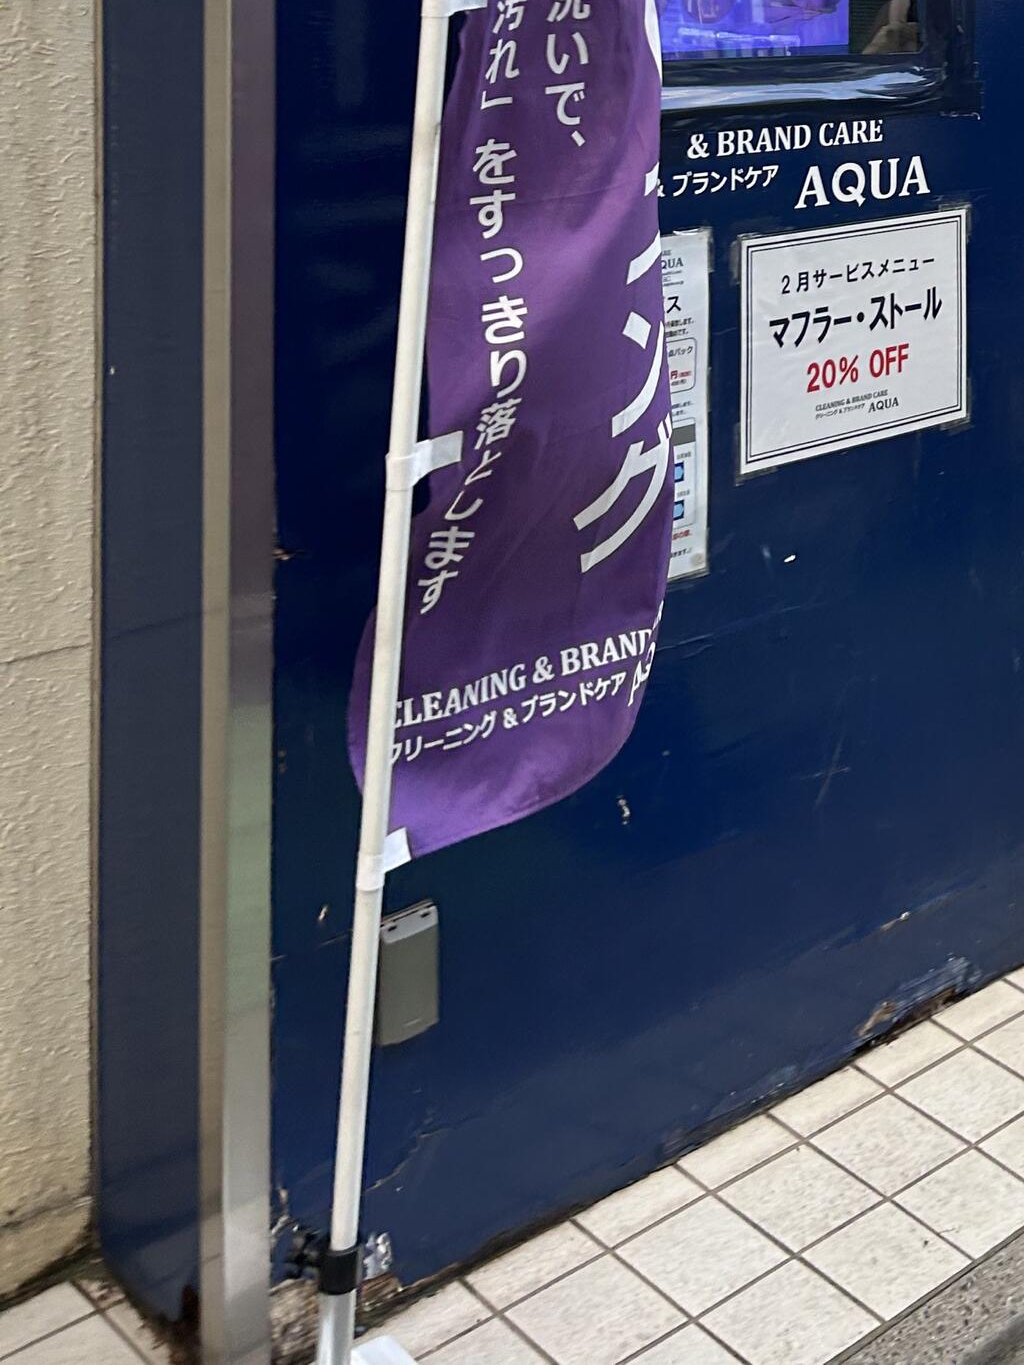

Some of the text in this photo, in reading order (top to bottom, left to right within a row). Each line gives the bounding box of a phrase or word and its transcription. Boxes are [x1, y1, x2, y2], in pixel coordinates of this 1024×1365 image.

[686, 118, 884, 160] & BRAND CARE
[672, 164, 780, 198] ブランドケア
[794, 155, 931, 209] AQUA
[781, 258, 935, 295] 2月サービスメニュー
[769, 286, 943, 349] マフラー・ストール
[806, 342, 910, 393] 20% OFF
[815, 397, 845, 412] CLEANING
[851, 392, 873, 404] BRAND
[873, 389, 889, 399] CARE
[868, 396, 899, 413] AQUA
[532, 655, 556, 685] &
[521, 670, 627, 724] ブランドケア
